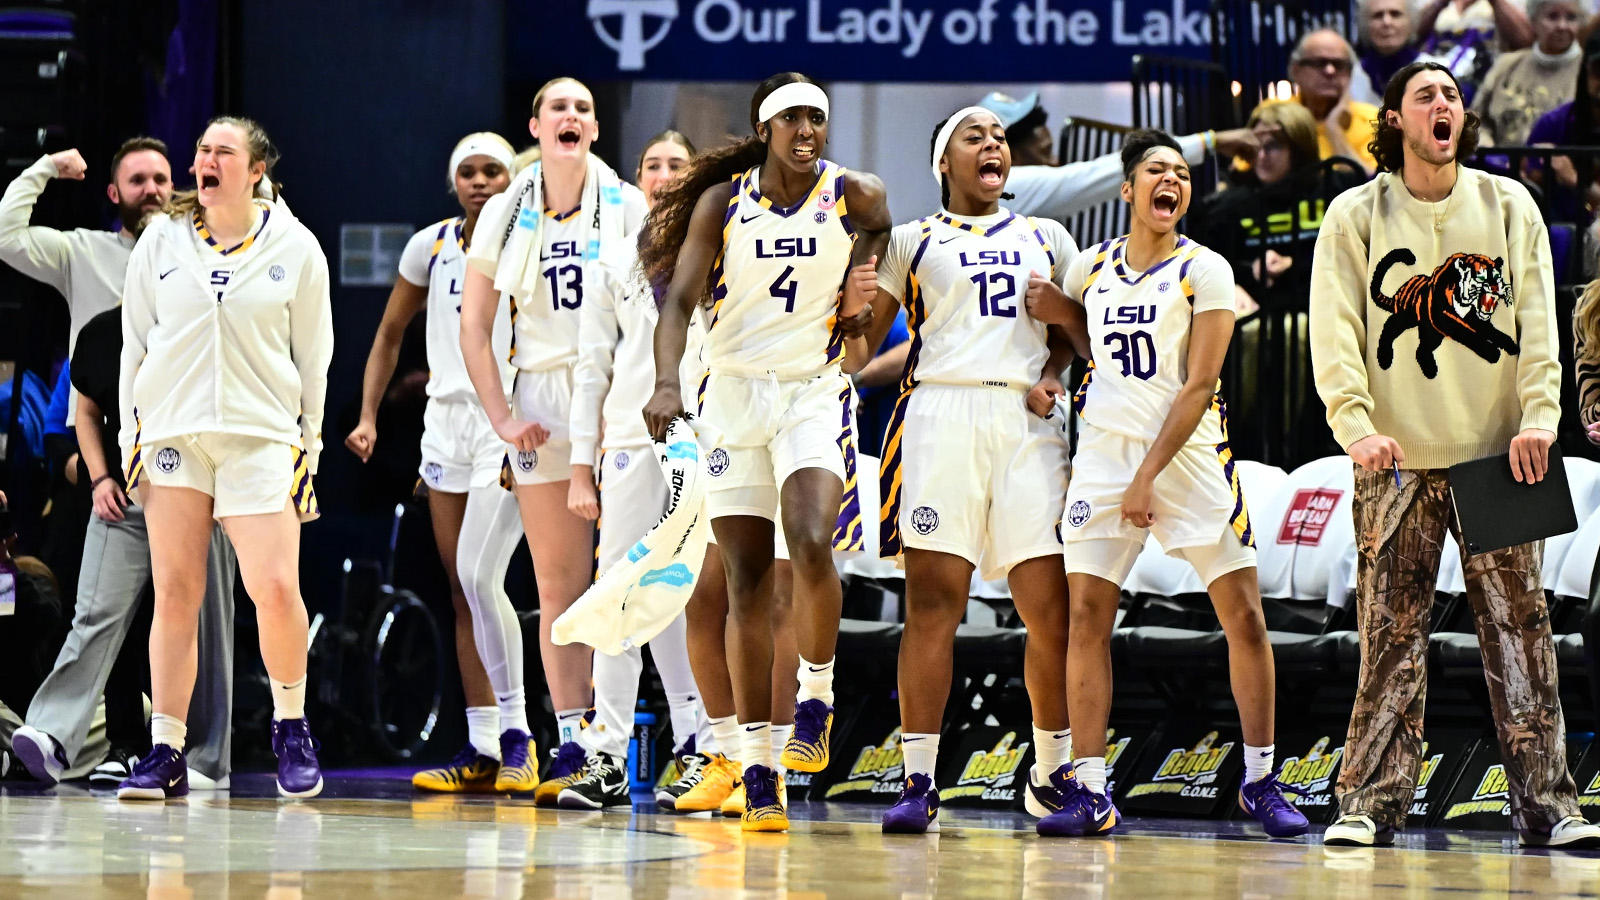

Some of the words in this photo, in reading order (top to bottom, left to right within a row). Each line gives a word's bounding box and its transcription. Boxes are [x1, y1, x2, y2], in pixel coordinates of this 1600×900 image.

[693, 0, 796, 42] Our
[807, 0, 934, 58] Lady
[942, 0, 999, 45] of
[1012, 0, 1100, 46] the
[755, 237, 817, 259] LSU
[958, 250, 1022, 268] LSU
[542, 263, 584, 311] 13
[768, 264, 799, 313] 4
[969, 271, 1017, 318] 12
[1103, 304, 1157, 326] LSU
[1103, 329, 1157, 381] 30
[1156, 743, 1231, 780] Bengal
[1277, 749, 1342, 788] Bengal
